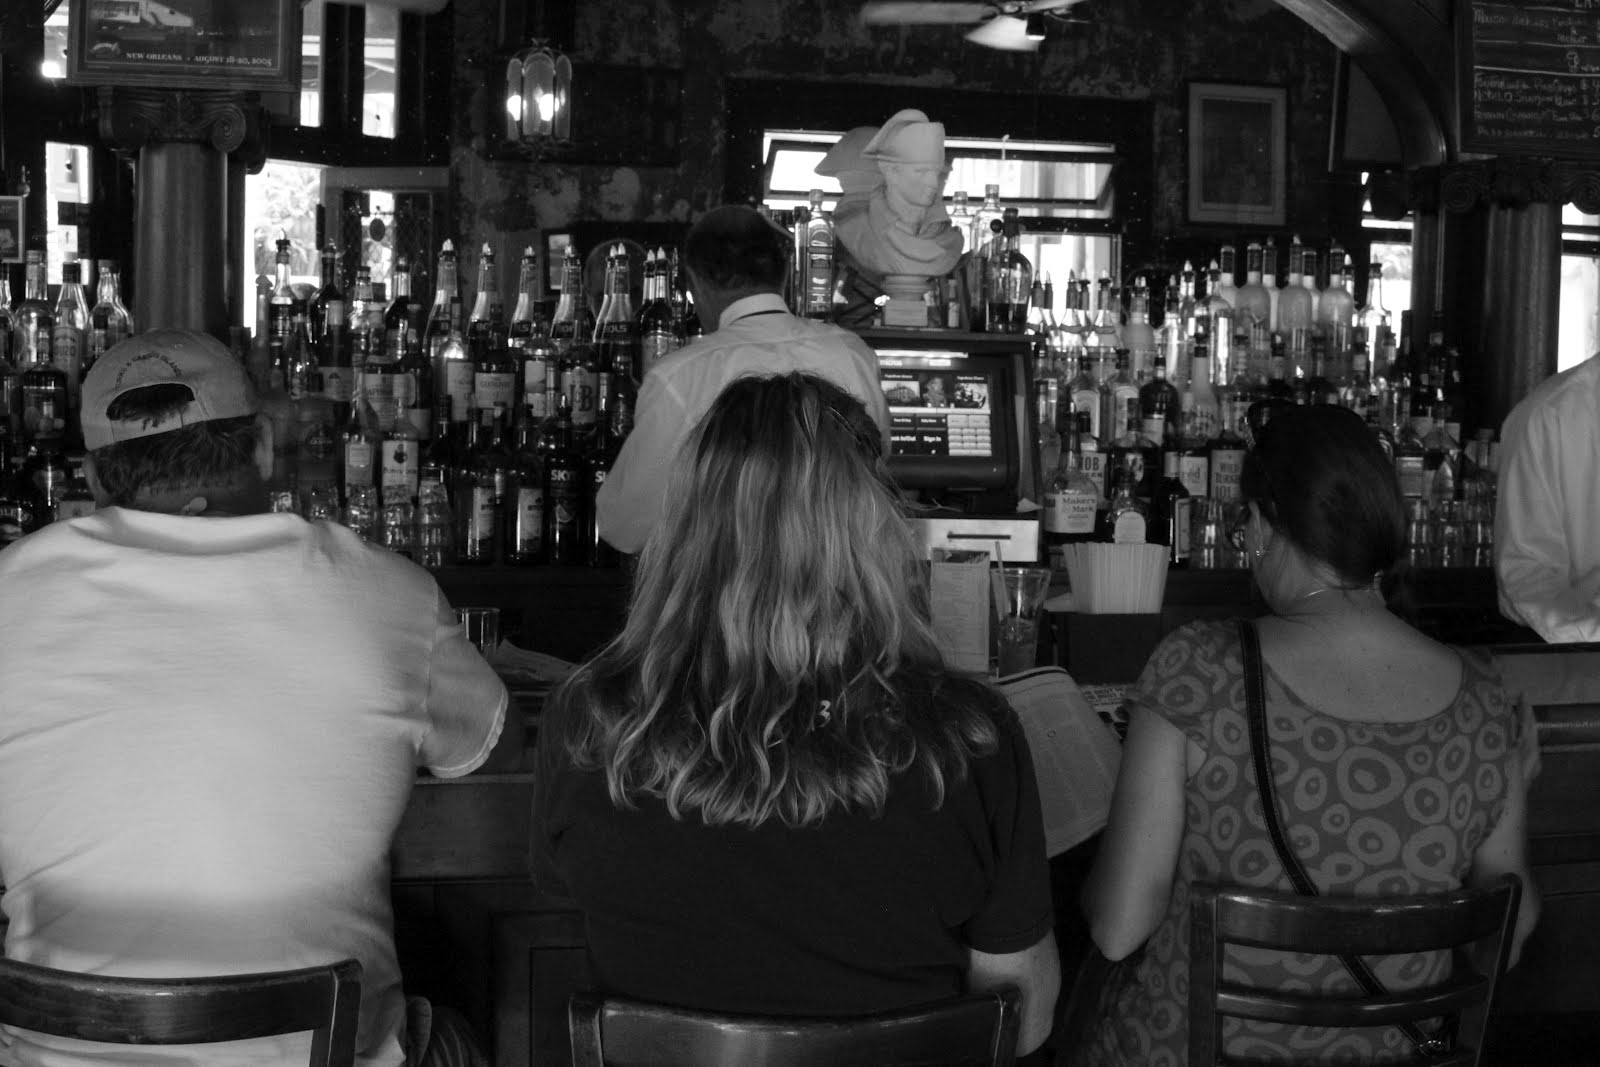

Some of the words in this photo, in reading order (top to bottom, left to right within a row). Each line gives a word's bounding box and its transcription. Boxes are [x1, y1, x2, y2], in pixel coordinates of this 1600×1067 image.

[146, 53, 182, 61] ORLEANS
[193, 55, 223, 64] AUGUST
[1072, 505, 1097, 513] Mark
